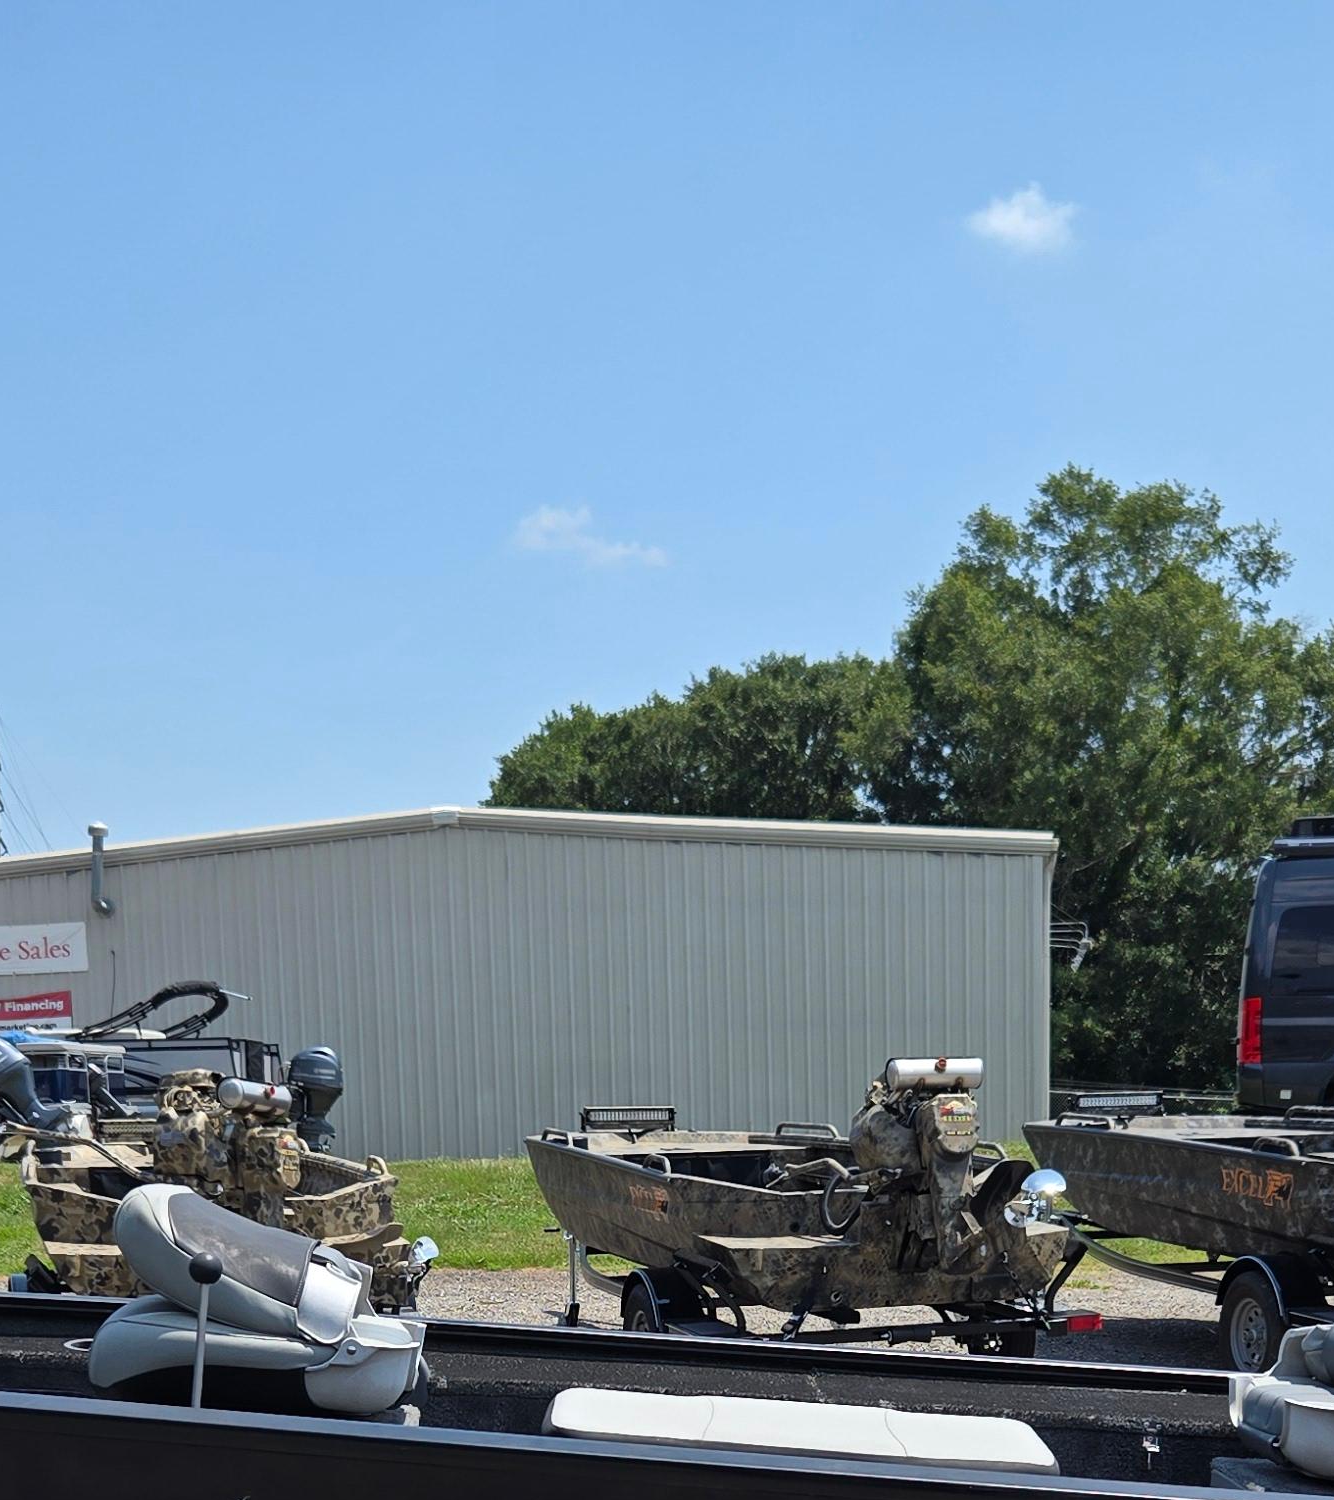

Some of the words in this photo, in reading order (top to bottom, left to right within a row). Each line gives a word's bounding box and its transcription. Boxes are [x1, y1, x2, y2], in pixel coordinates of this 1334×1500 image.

[18, 937, 71, 961] Sales
[5, 999, 64, 1012] Financing
[1220, 1167, 1265, 1199] EXCEL
